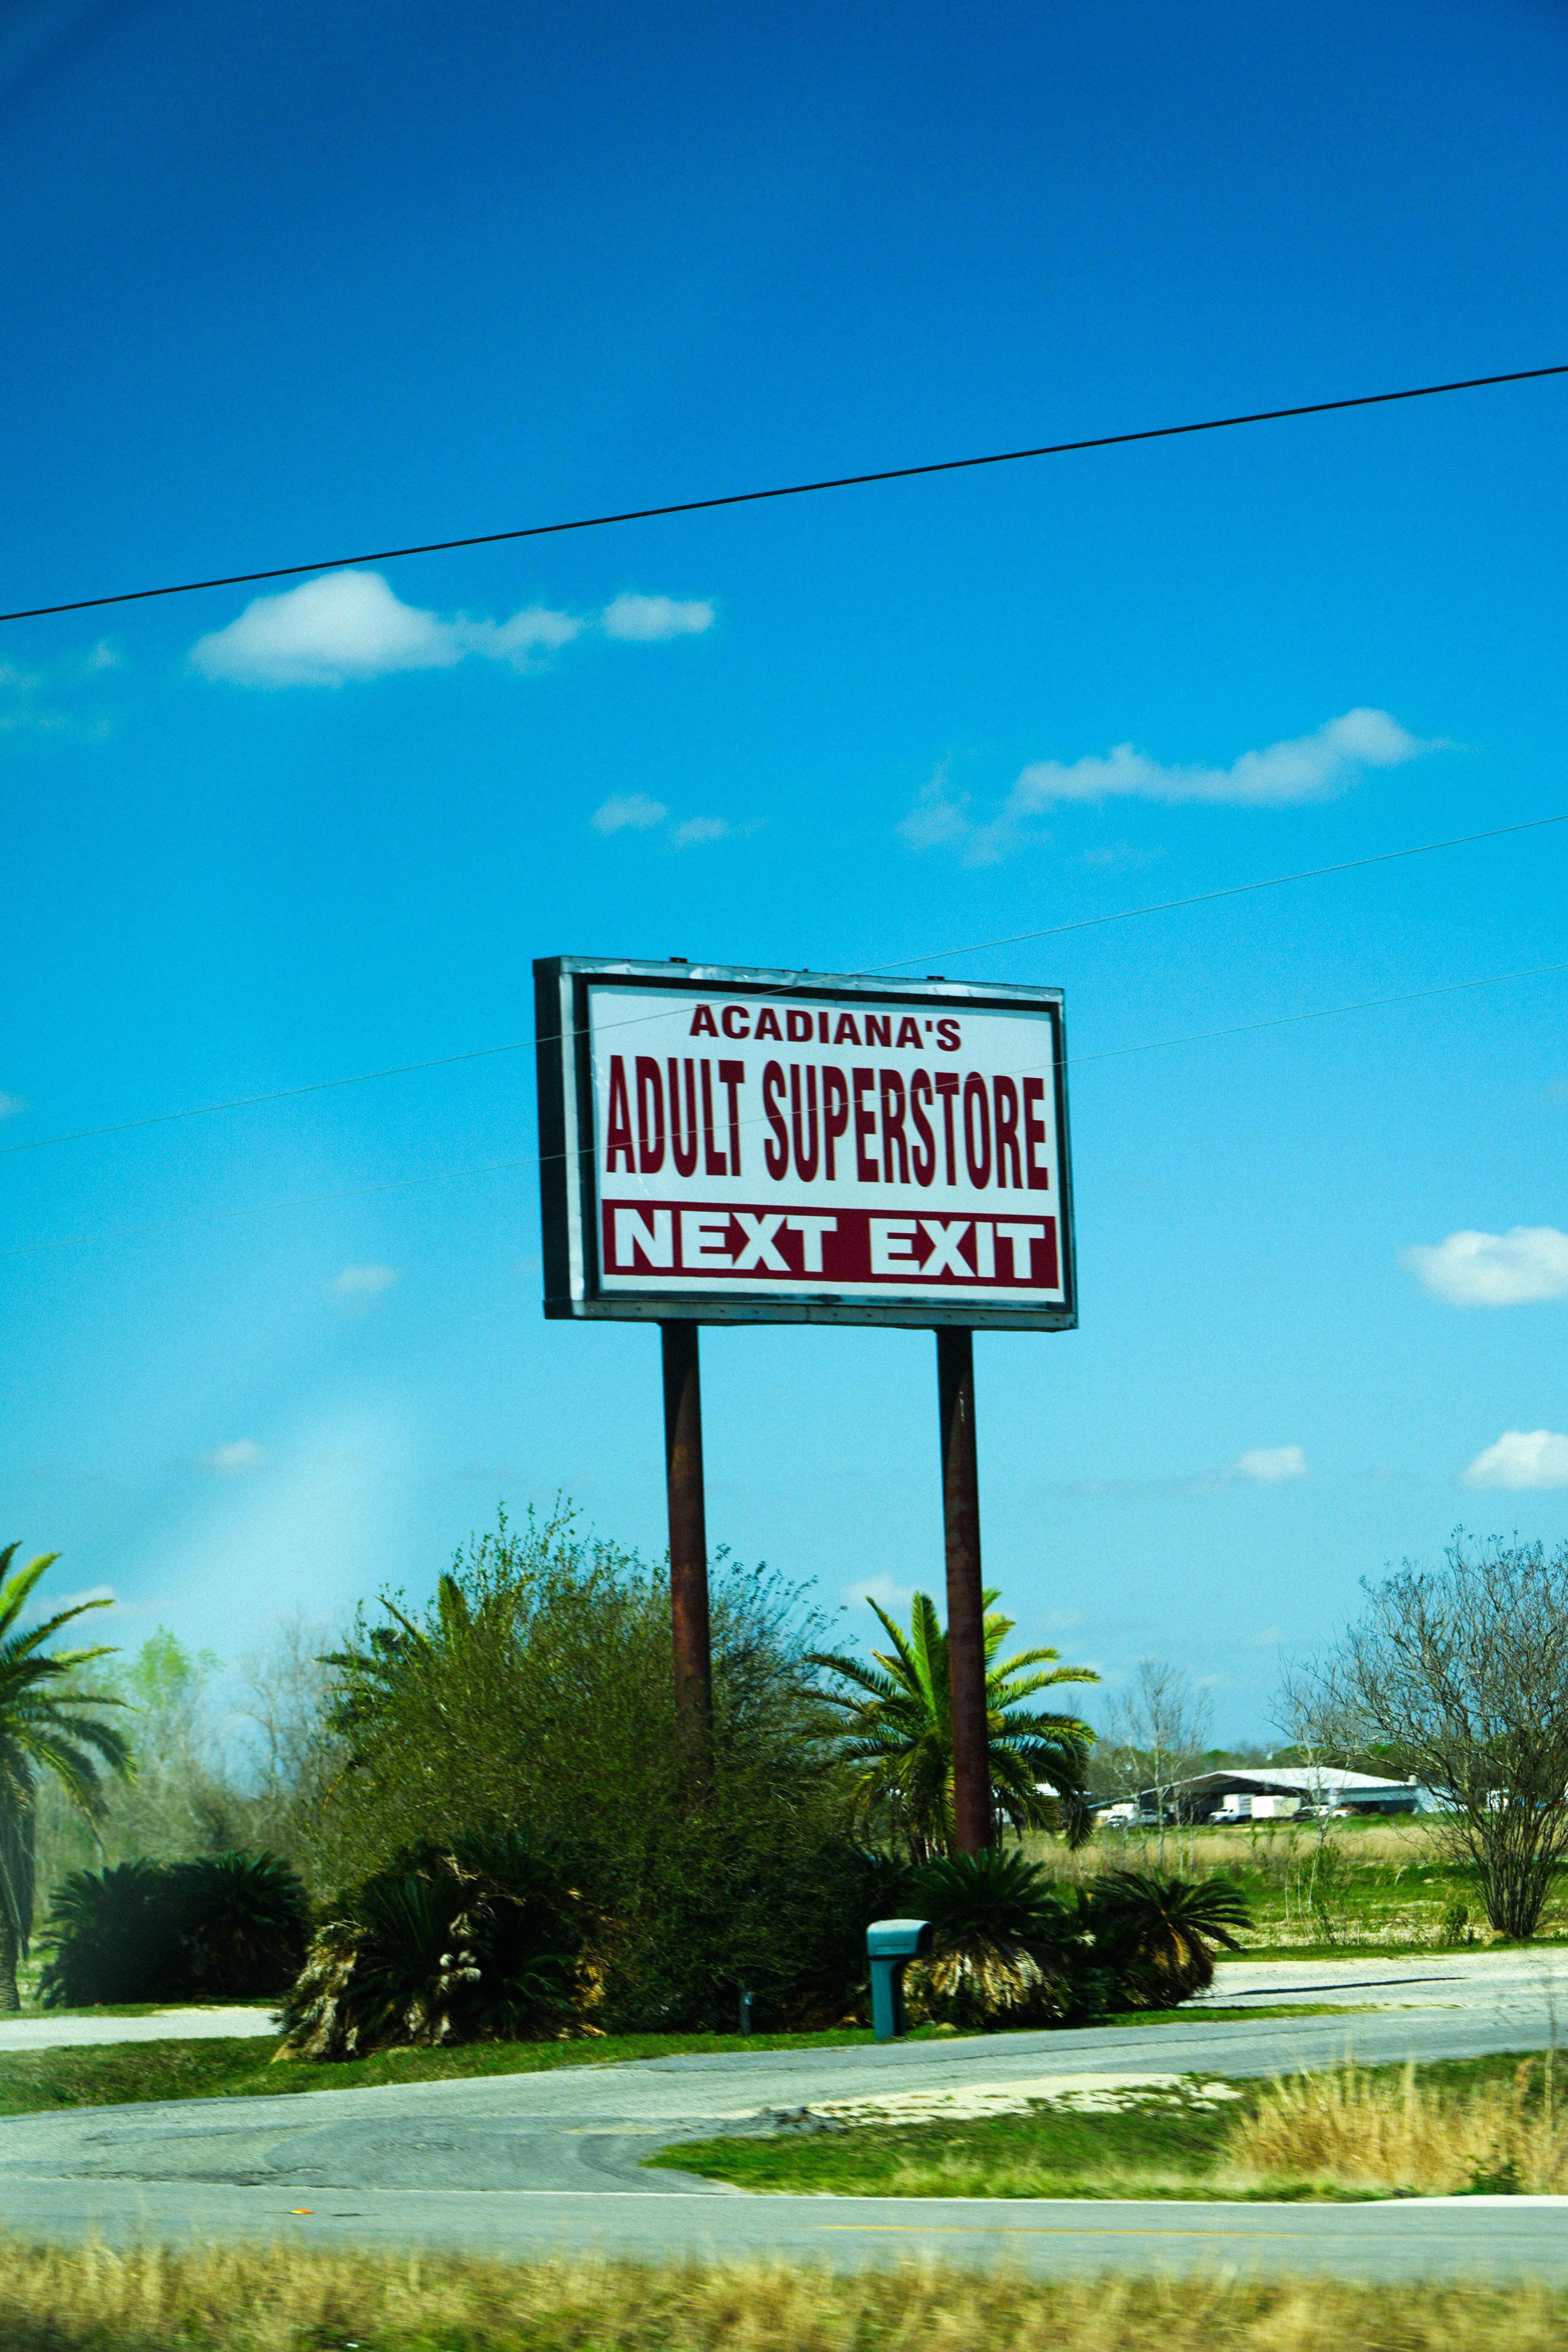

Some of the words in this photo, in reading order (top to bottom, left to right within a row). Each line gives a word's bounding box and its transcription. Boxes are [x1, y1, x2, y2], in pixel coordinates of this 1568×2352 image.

[690, 1005, 961, 1051] ACADIANA'S
[607, 1055, 744, 1177] ADULT
[763, 1061, 1049, 1190] SUPERSTORE
[614, 1209, 837, 1272] NEXT
[869, 1218, 1045, 1279] EXIT
